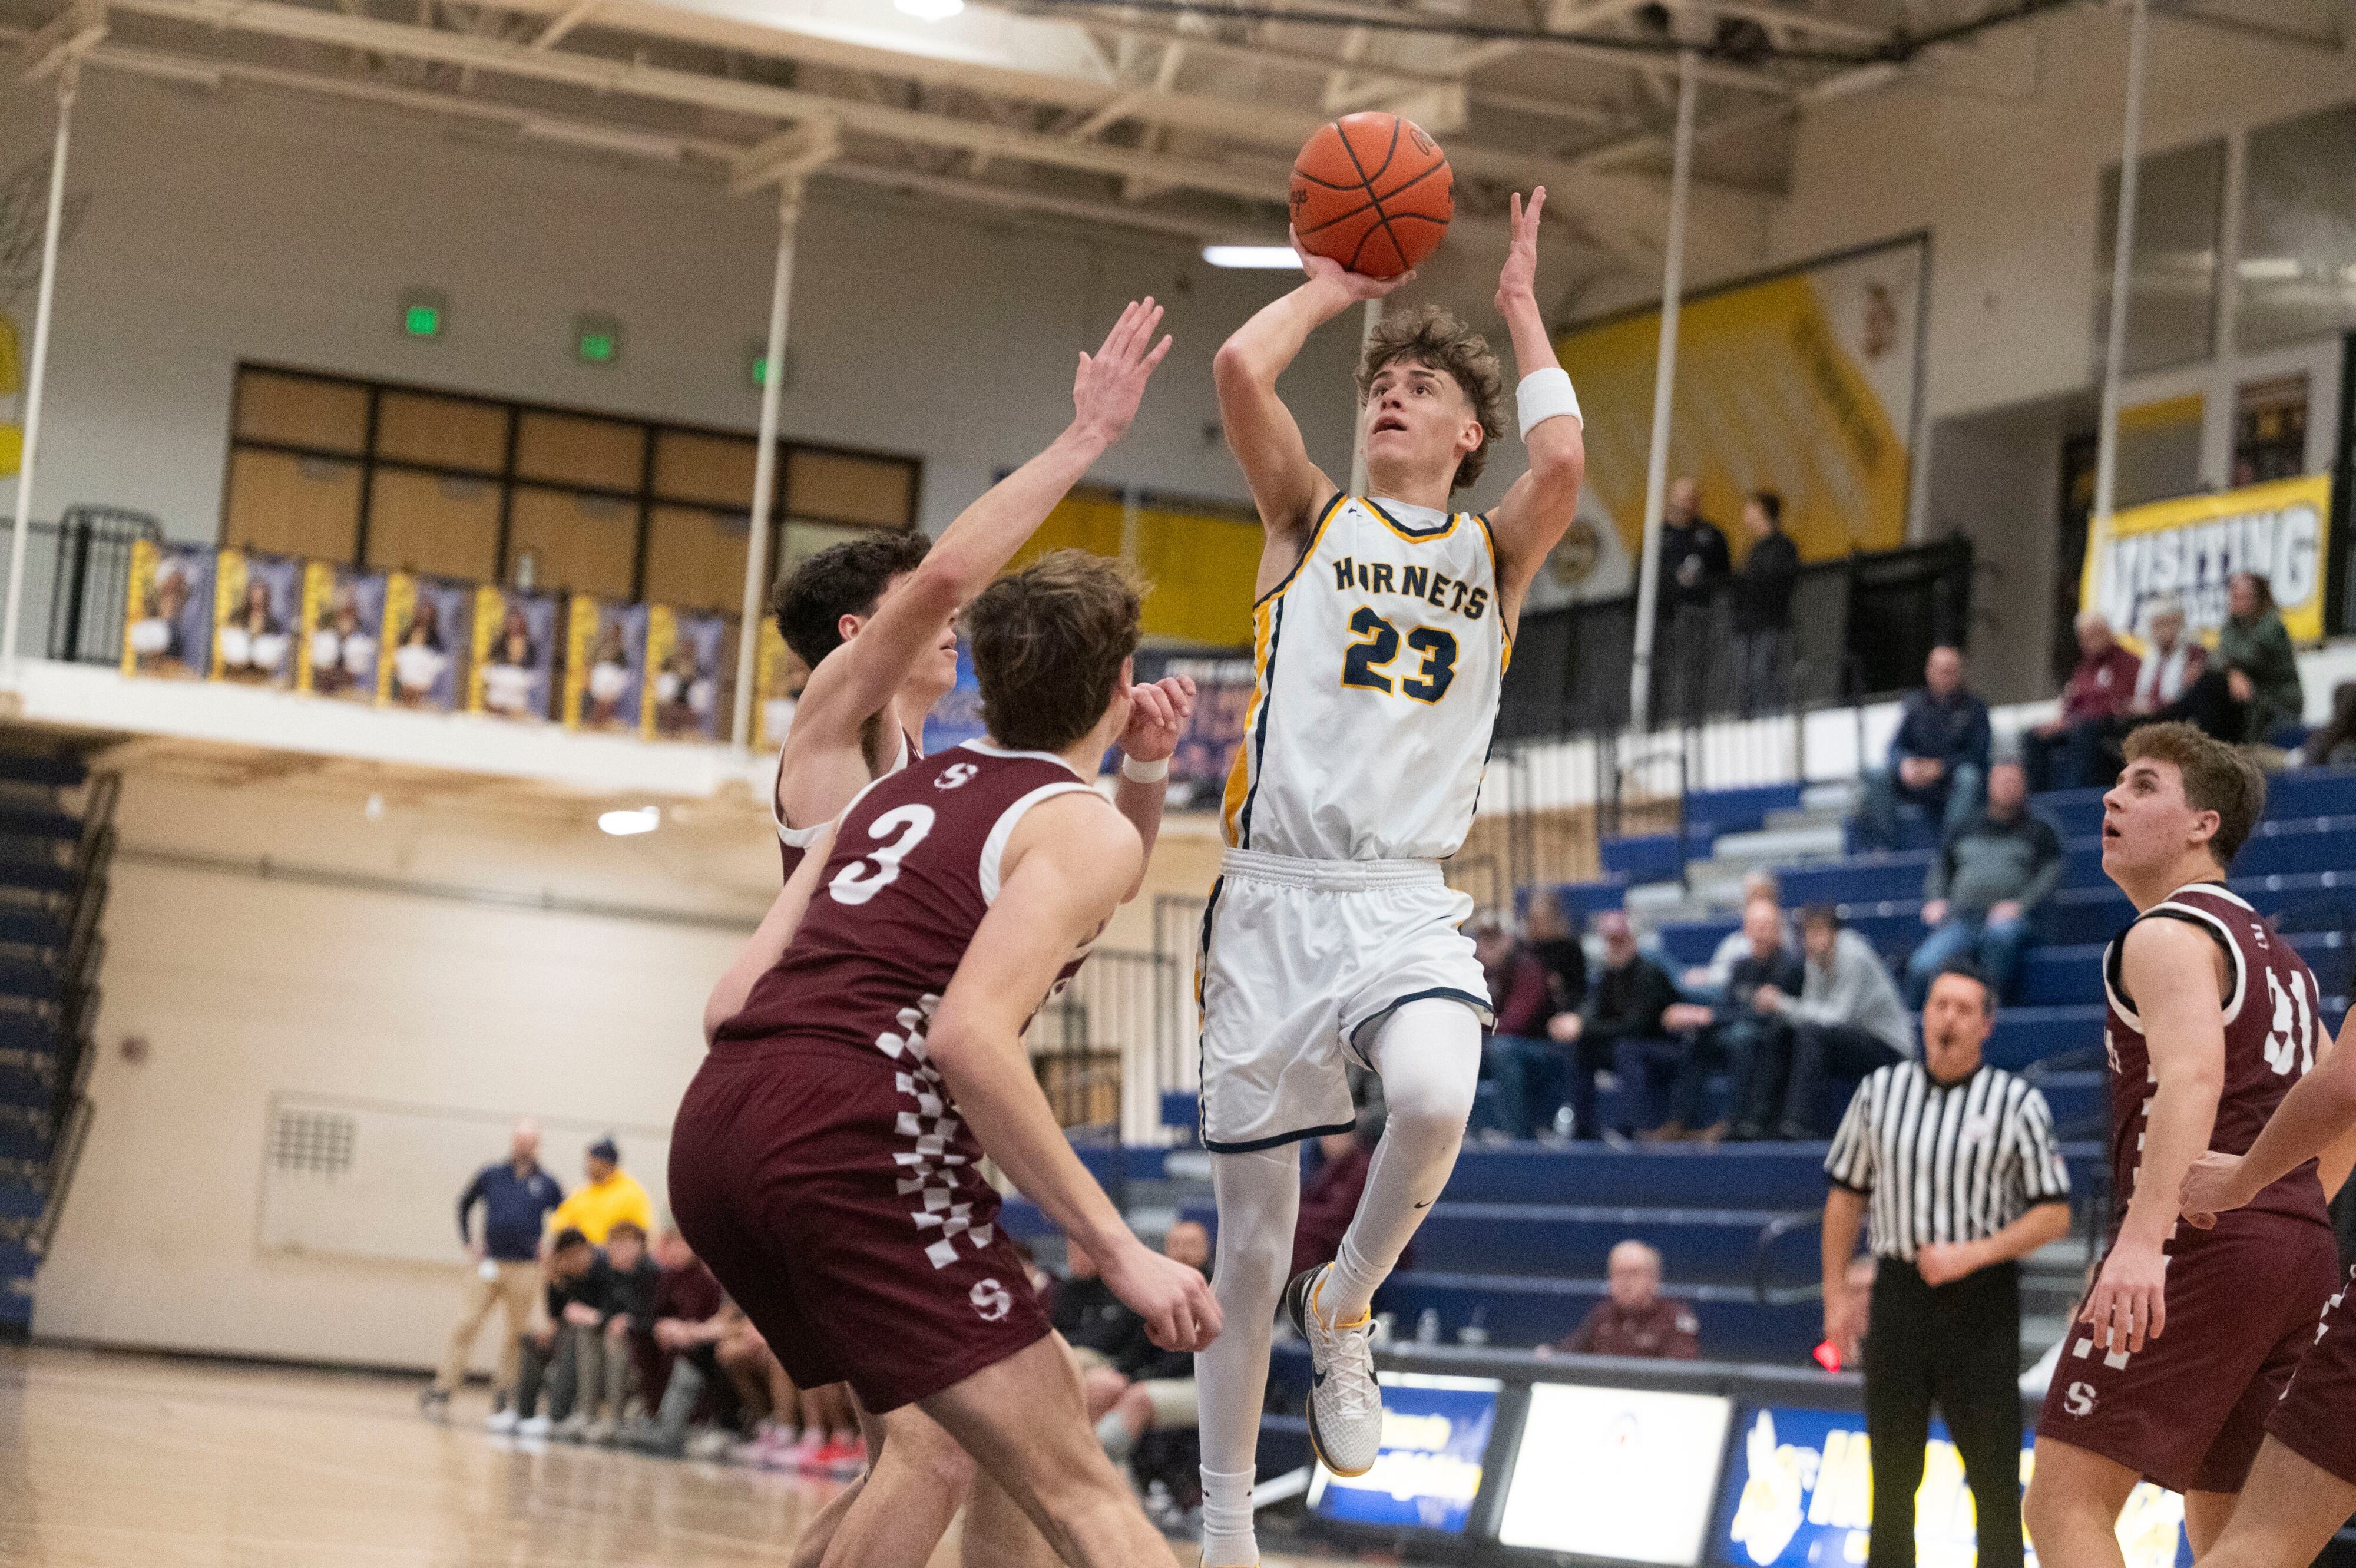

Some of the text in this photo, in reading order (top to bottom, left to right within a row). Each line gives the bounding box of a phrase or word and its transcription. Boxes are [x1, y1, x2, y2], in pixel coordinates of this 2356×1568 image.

[1341, 604, 1459, 705] 23
[933, 763, 978, 789] S
[829, 803, 935, 905] 3
[969, 1278, 1012, 1321] S
[2063, 1382, 2097, 1416] S
